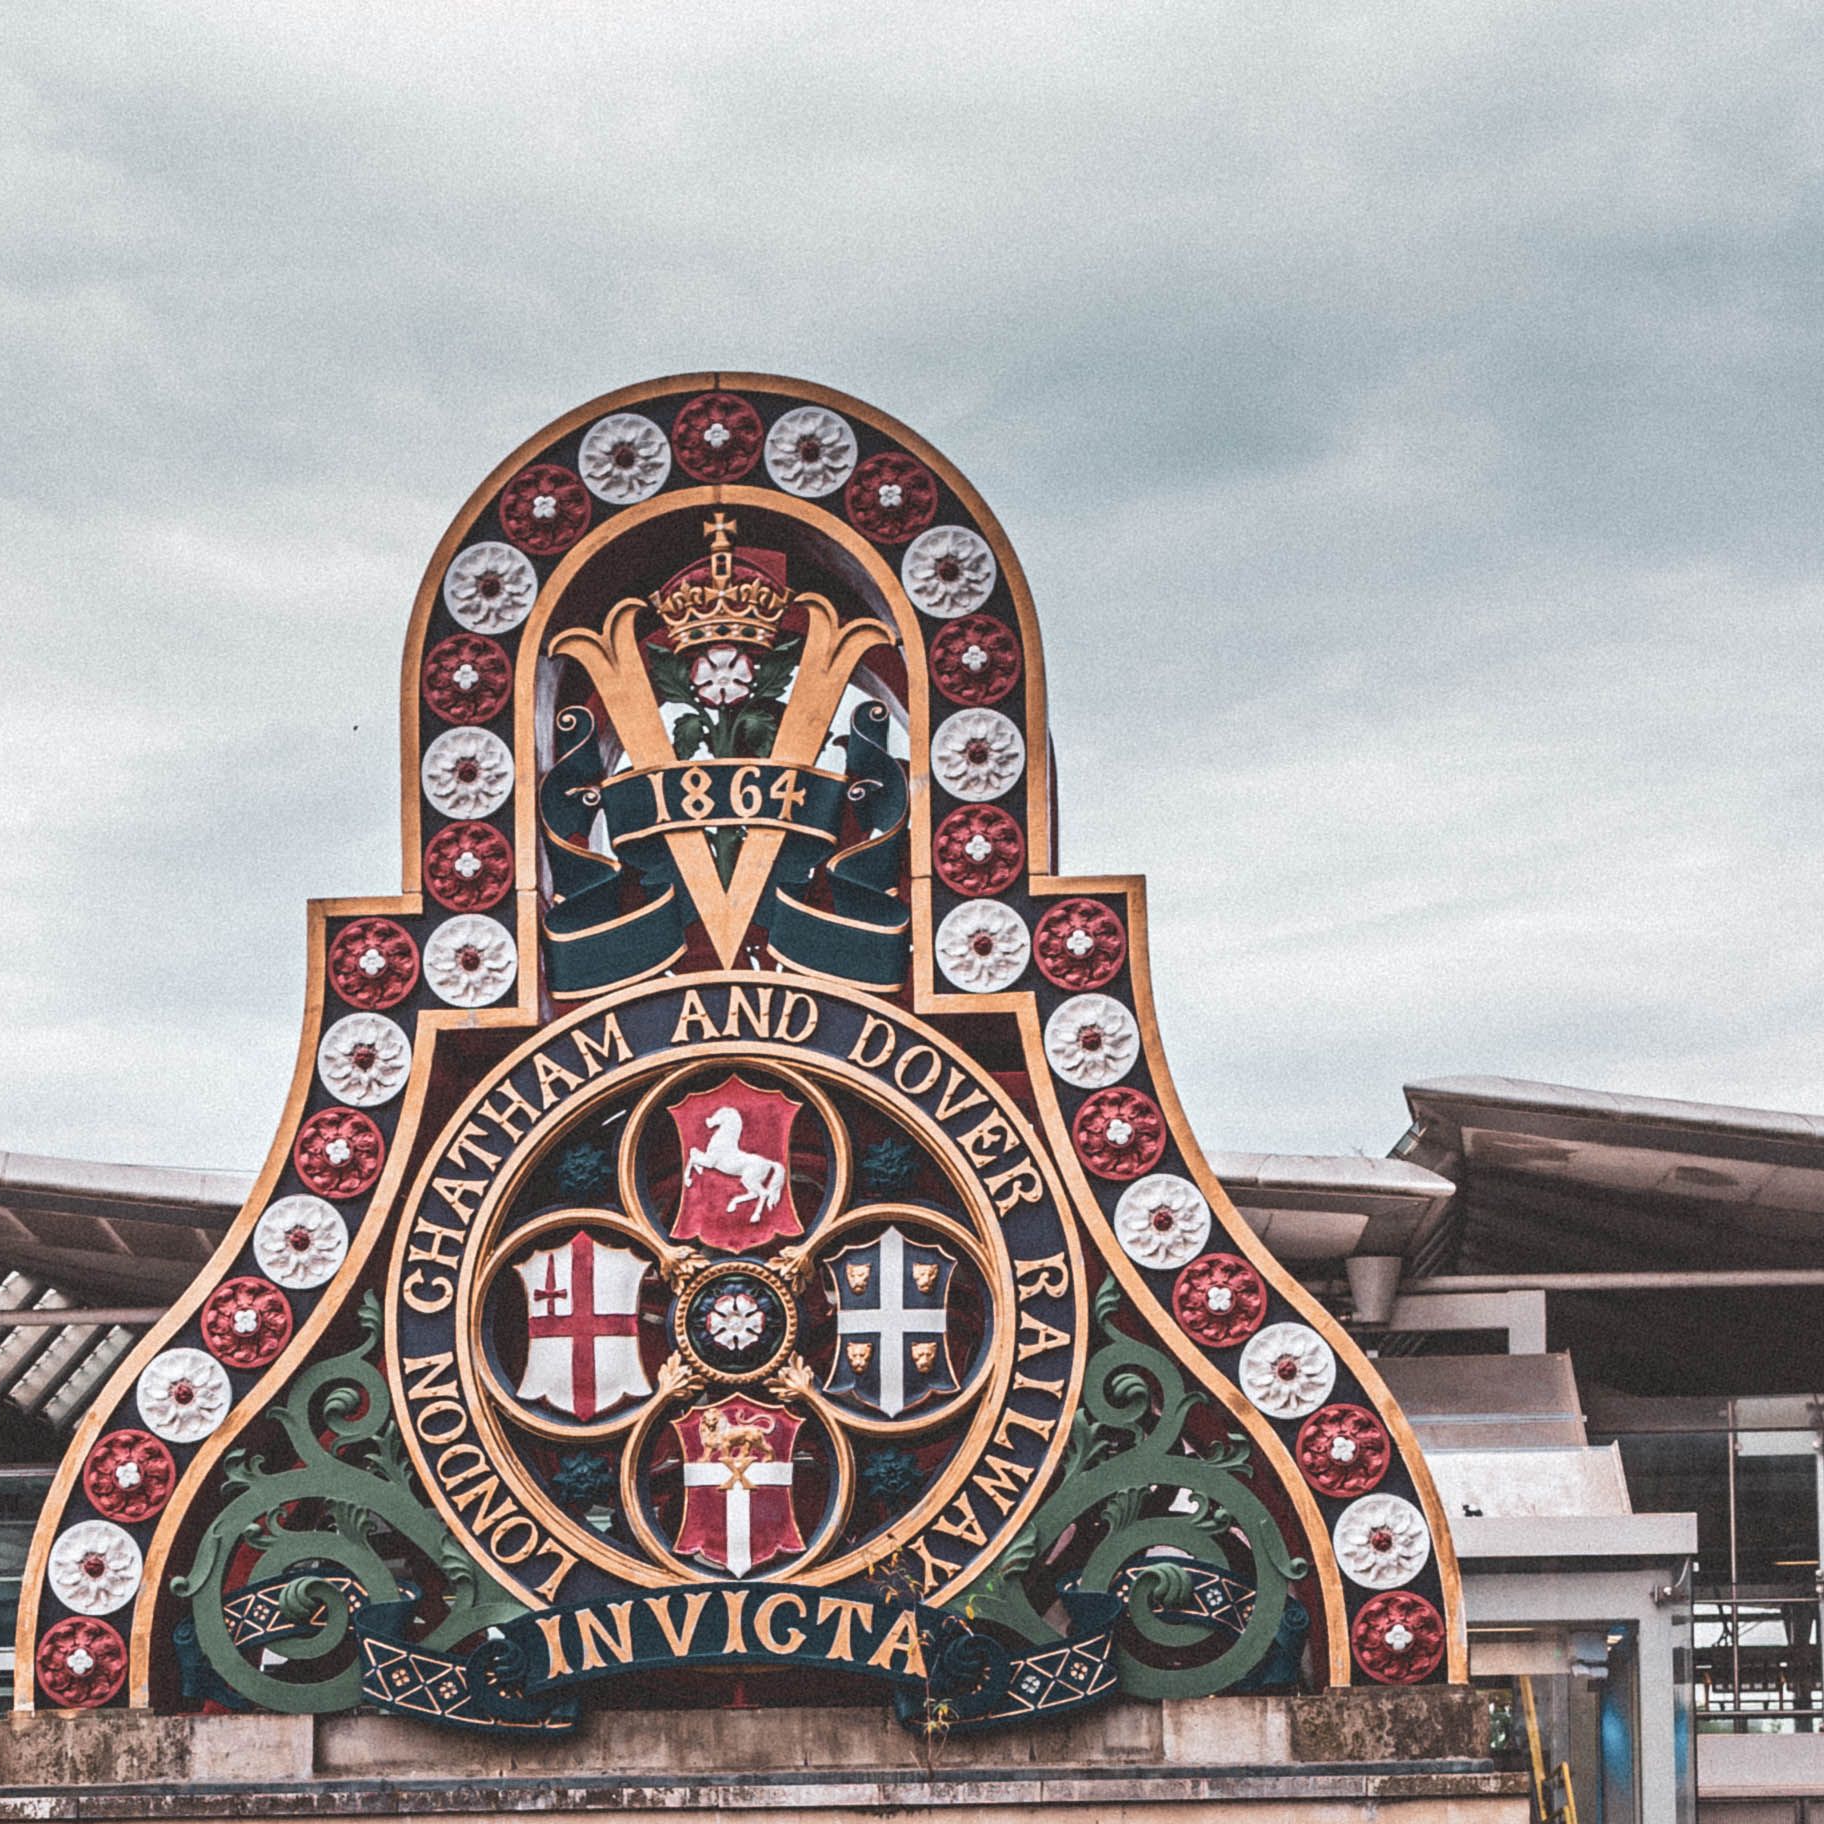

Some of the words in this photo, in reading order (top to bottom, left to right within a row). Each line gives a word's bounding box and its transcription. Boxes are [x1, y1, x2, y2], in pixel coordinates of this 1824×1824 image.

[646, 765, 808, 824] 1864
[670, 986, 819, 1043] AND
[847, 1013, 1044, 1218] DOVER
[402, 1012, 635, 1314] CHATHAM
[402, 1350, 580, 1603] LONDON
[908, 1251, 1071, 1596] RAILWAY
[535, 1588, 928, 1680] INVICTA
